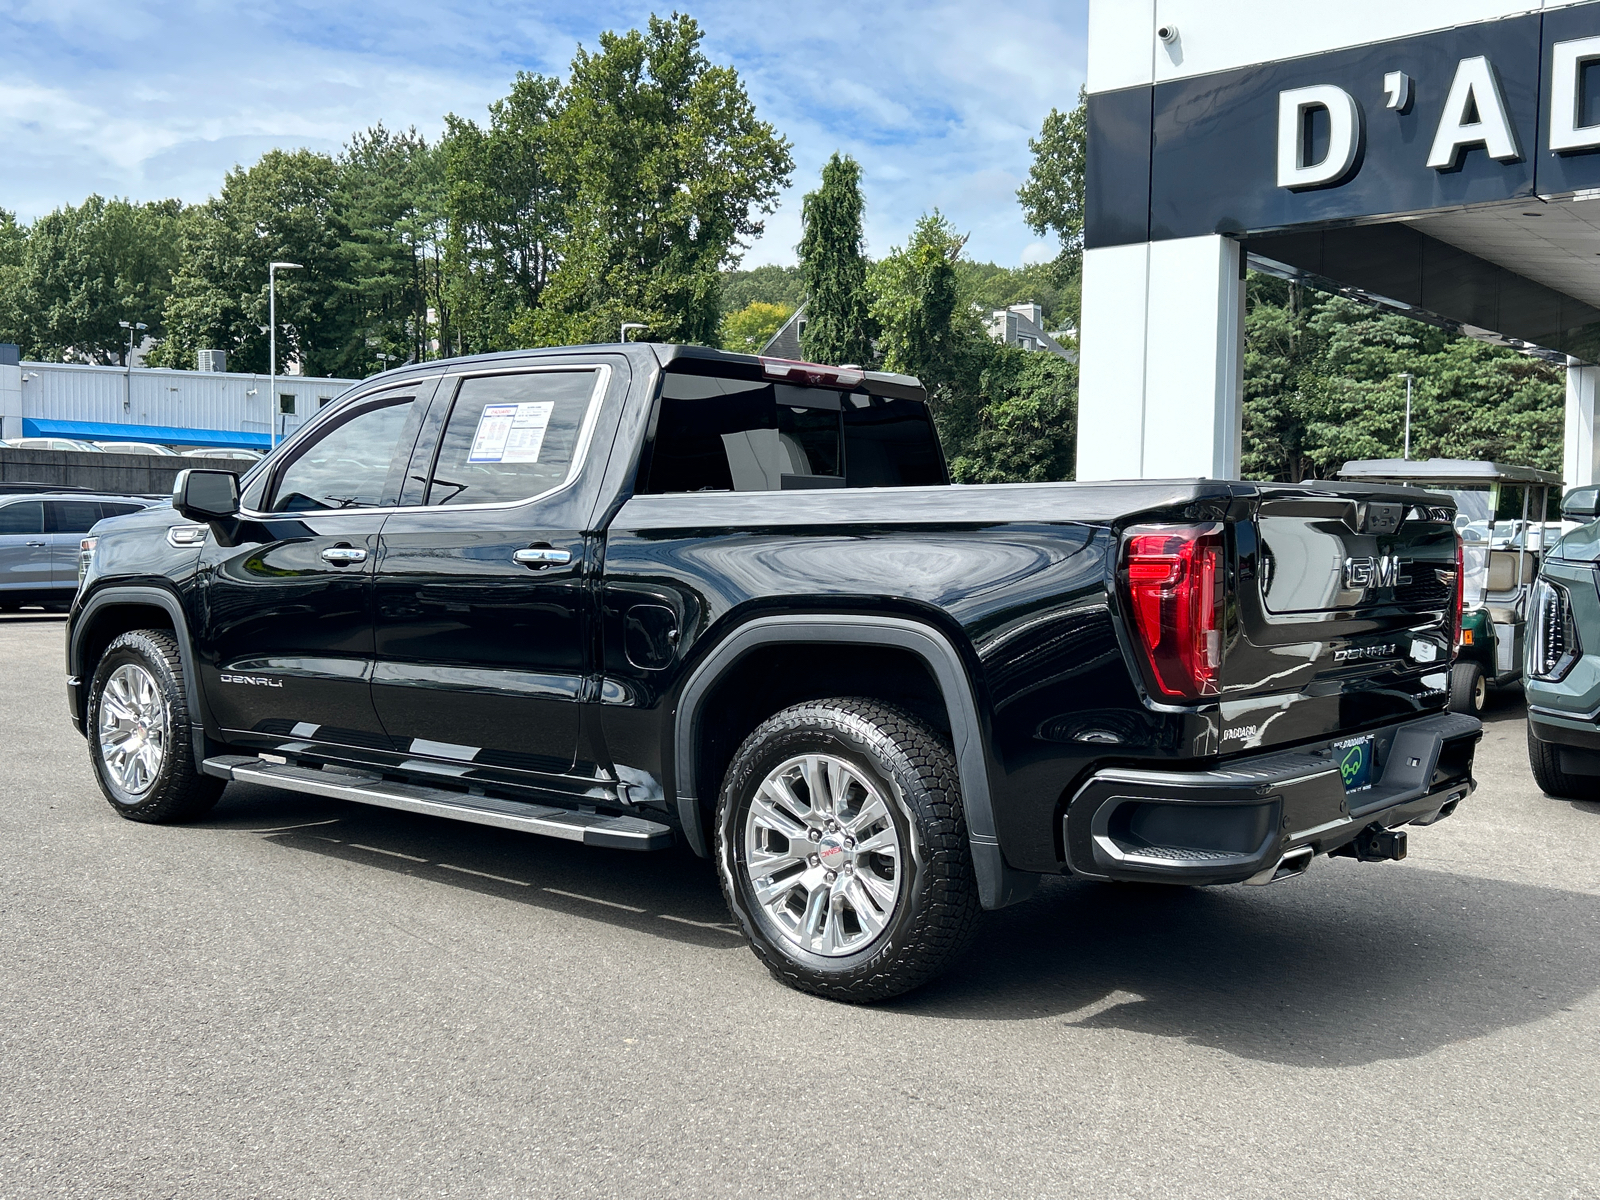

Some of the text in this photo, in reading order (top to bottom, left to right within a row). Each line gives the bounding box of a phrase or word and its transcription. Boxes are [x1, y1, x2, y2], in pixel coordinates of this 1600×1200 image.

[1345, 555, 1413, 588] GMC
[1334, 644, 1396, 661] DENALI
[220, 674, 283, 688] DENALI
